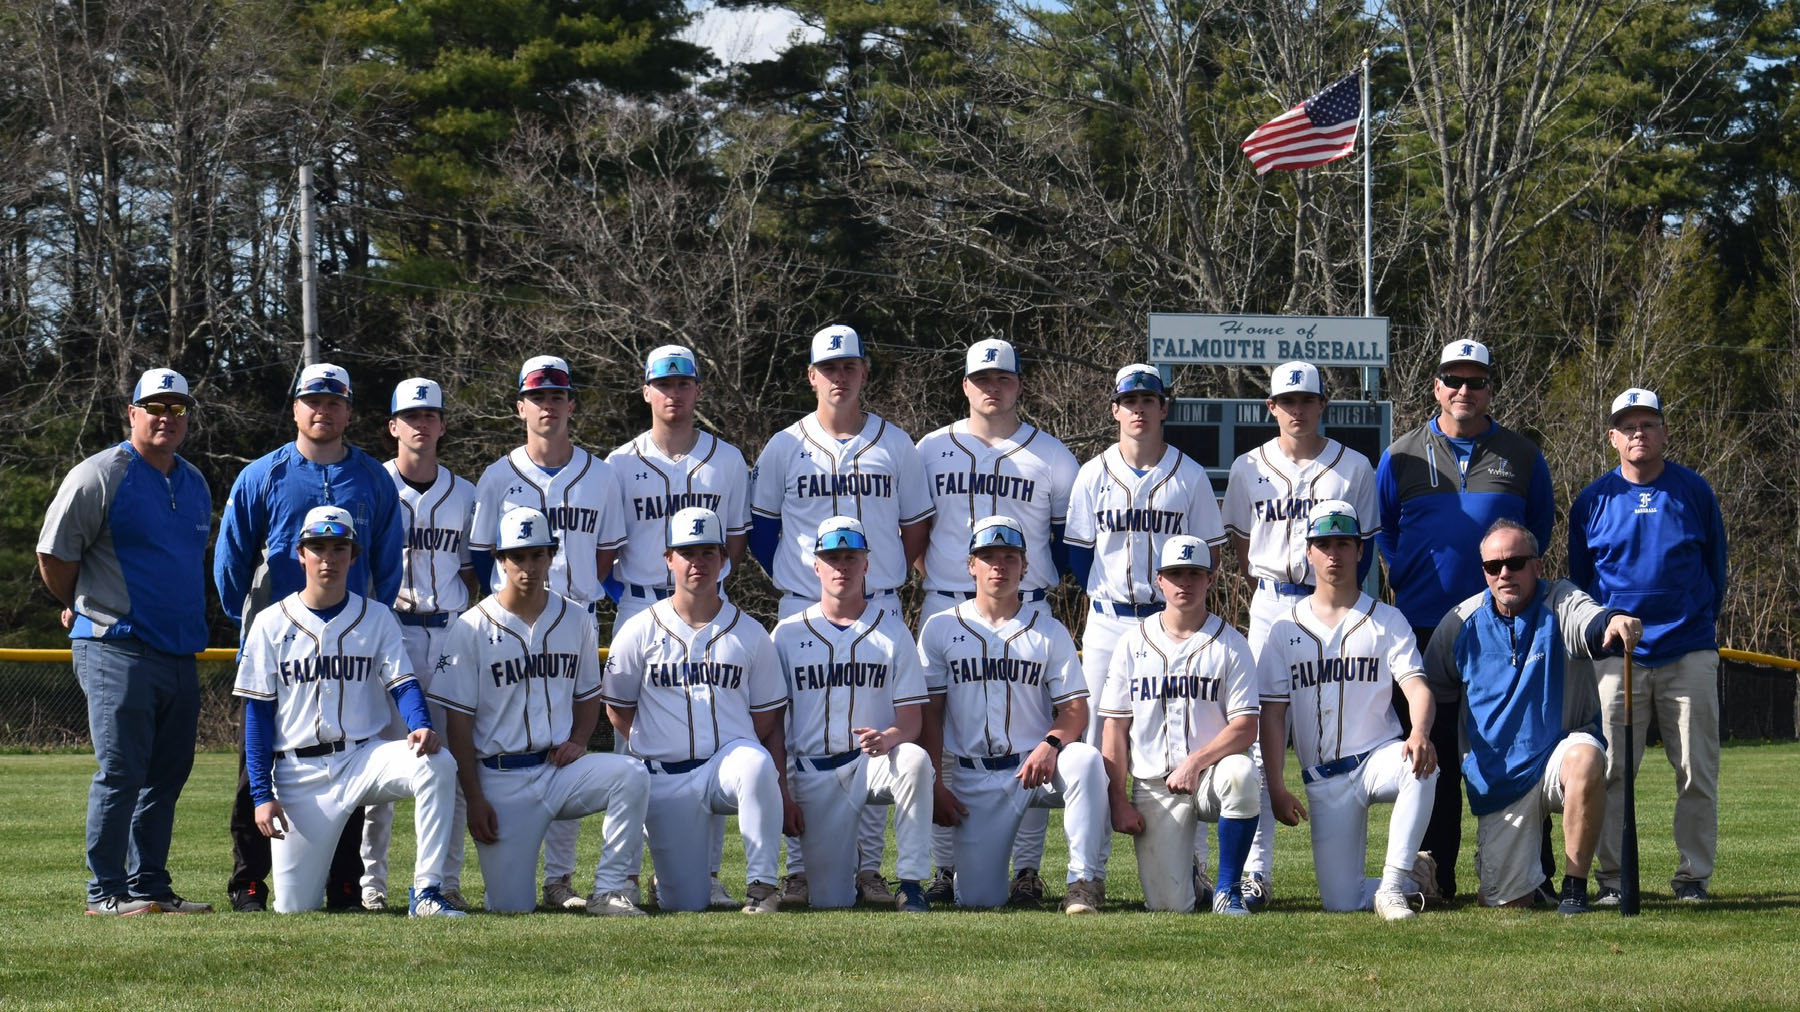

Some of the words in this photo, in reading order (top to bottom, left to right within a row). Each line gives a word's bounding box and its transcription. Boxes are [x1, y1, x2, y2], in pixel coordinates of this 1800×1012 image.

[1219, 320, 1286, 335] Home
[1296, 323, 1317, 339] of
[1152, 338, 1266, 359] FALMOUTH
[1278, 340, 1383, 360] BASEBALL
[797, 473, 891, 498] FALMOUTH
[935, 472, 1035, 503] FALMOUTH
[1096, 508, 1184, 535] FALMOUTH
[491, 653, 578, 688] FALMOUTH
[650, 662, 743, 690] FALMOUTH
[794, 662, 888, 691] FALMOUTH
[950, 657, 1042, 686] FALMOUTH
[1291, 656, 1380, 691] FALMOUTH
[1130, 675, 1222, 702] FALMOUTH
